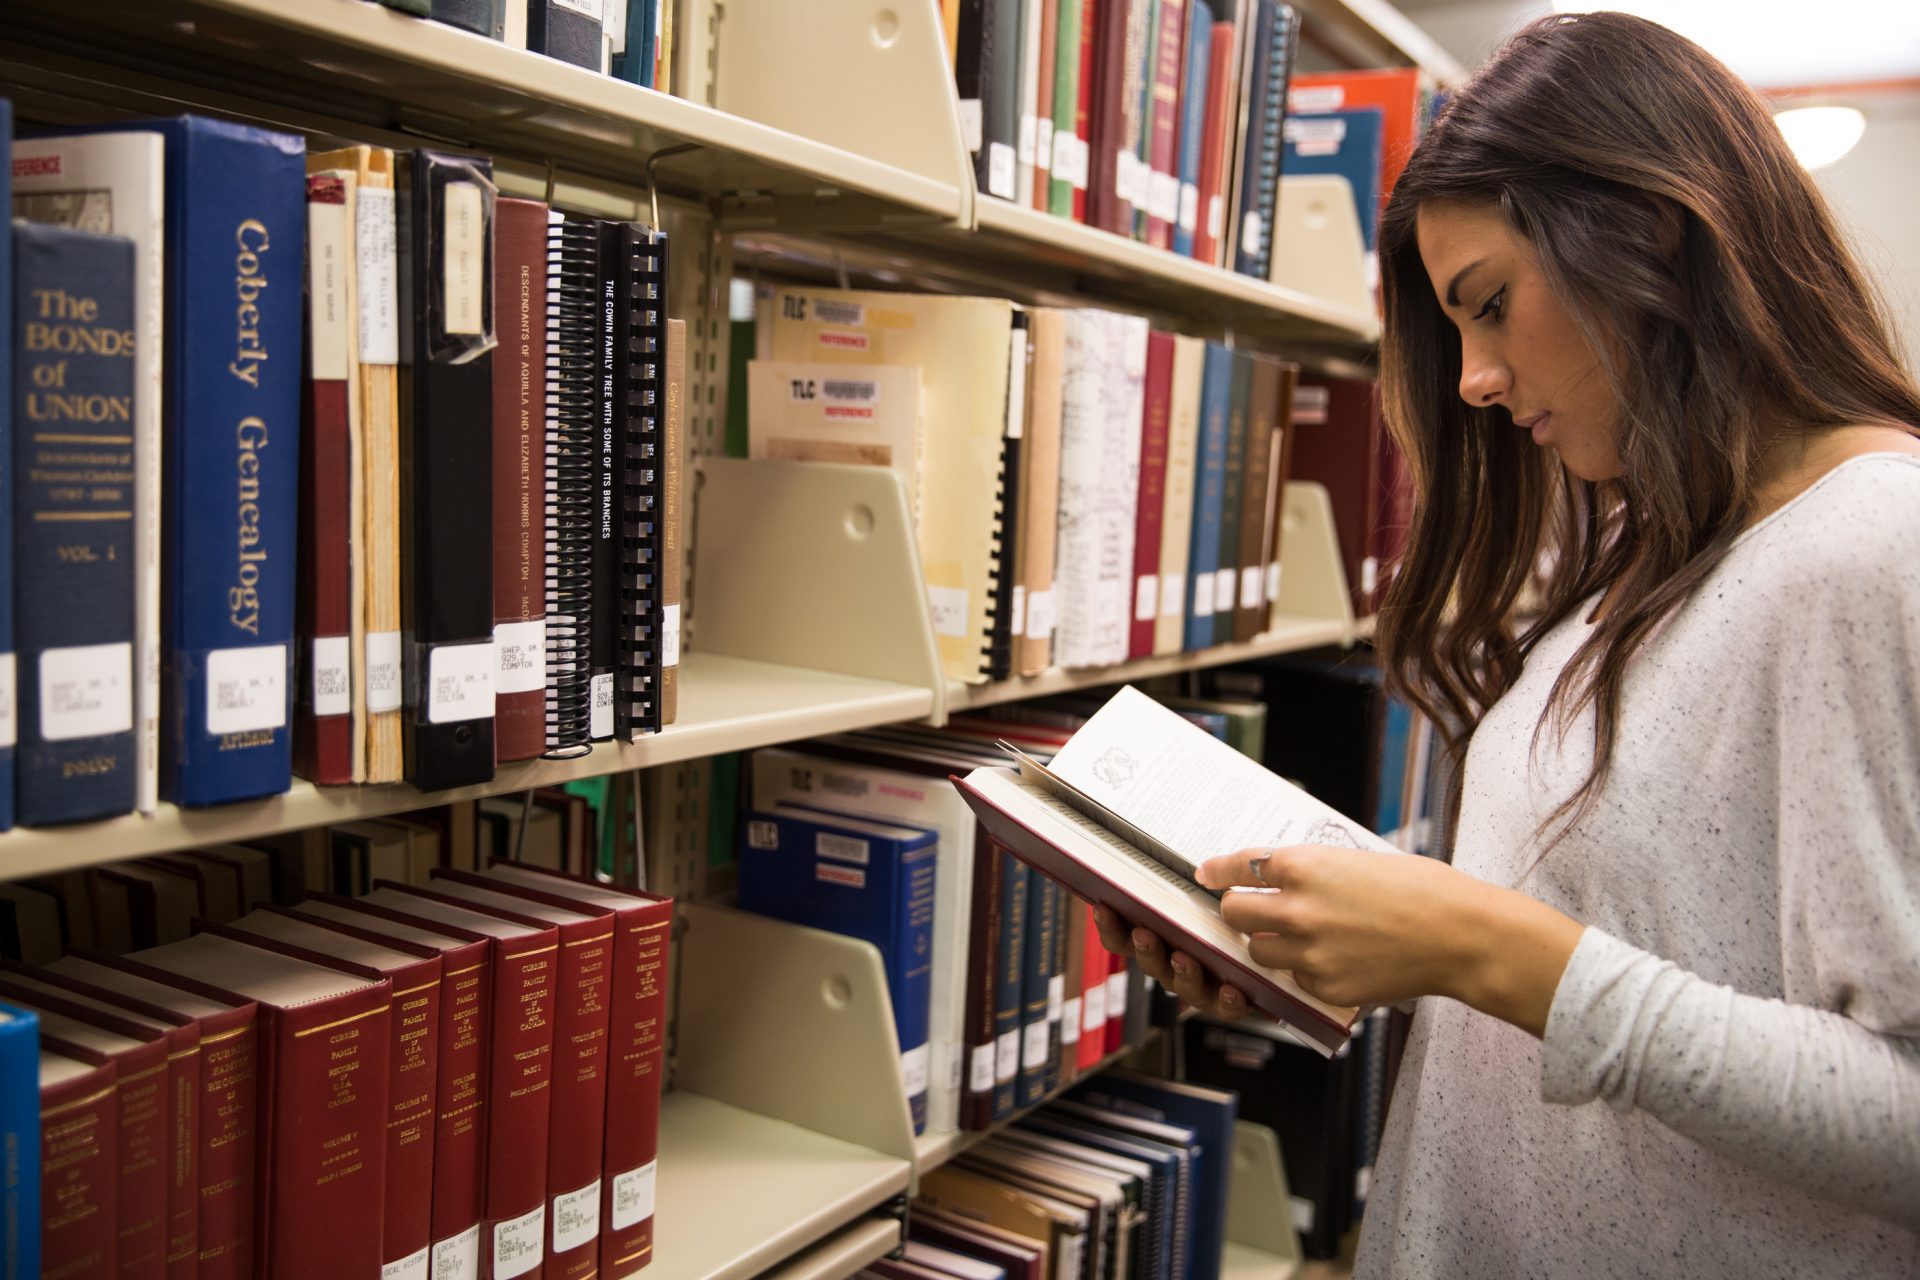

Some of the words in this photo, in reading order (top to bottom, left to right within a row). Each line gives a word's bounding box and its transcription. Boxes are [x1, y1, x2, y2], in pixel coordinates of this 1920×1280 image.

[12, 156, 61, 176] EFERENCE
[605, 280, 614, 298] THE
[32, 288, 97, 321] The
[229, 219, 270, 387] Coberly
[521, 265, 530, 340] DESCENDANTS
[604, 301, 614, 333] COWIN
[25, 324, 136, 356] BONDS
[521, 344, 529, 357] OF
[604, 335, 613, 370] FAMILY
[33, 360, 68, 388] of
[521, 361, 529, 405] AQUILLA
[604, 374, 613, 398] TREE
[791, 380, 816, 399] TLC
[27, 394, 130, 421] UNION
[603, 401, 612, 424] WITH
[521, 409, 529, 430] AND
[603, 428, 612, 454] SOME
[521, 434, 529, 488] ELIZABETH
[603, 457, 612, 468] OF
[602, 473, 611, 486] ITS
[521, 492, 529, 528] NORRIS
[602, 490, 611, 539] BRANCHES
[229, 416, 269, 634] Genealogy
[521, 531, 529, 580] COMPTON
[501, 661, 533, 671] COMPTON
[579, 948, 603, 959] CURRIER
[522, 961, 548, 973] CURRIER
[456, 978, 479, 990] CURRIER
[523, 975, 546, 987] FAMILY
[456, 992, 478, 1005] FAMILY
[520, 989, 548, 1002] RECORDS
[402, 997, 429, 1011] CURRIER
[402, 1013, 427, 1026] FAMILY
[453, 1007, 479, 1021] RECORDS
[520, 1020, 546, 1031] CANADA
[330, 1029, 360, 1044] CURRIER
[400, 1027, 428, 1042] RECORDS
[453, 1037, 477, 1050] CANADA
[331, 1045, 358, 1060] FAMILY
[514, 1048, 540, 1061] VOLUME
[328, 1061, 359, 1077] RECORDS
[400, 1059, 426, 1072] CANADA
[394, 1097, 420, 1112] VOLUME
[323, 1133, 352, 1149] VOLUME
[499, 1224, 519, 1235] LOCAL
[437, 1241, 456, 1254] LOCAL
[498, 1240, 527, 1256] CURRIER
[384, 1265, 401, 1276] OCAL
[403, 1252, 426, 1271] HISTORY
